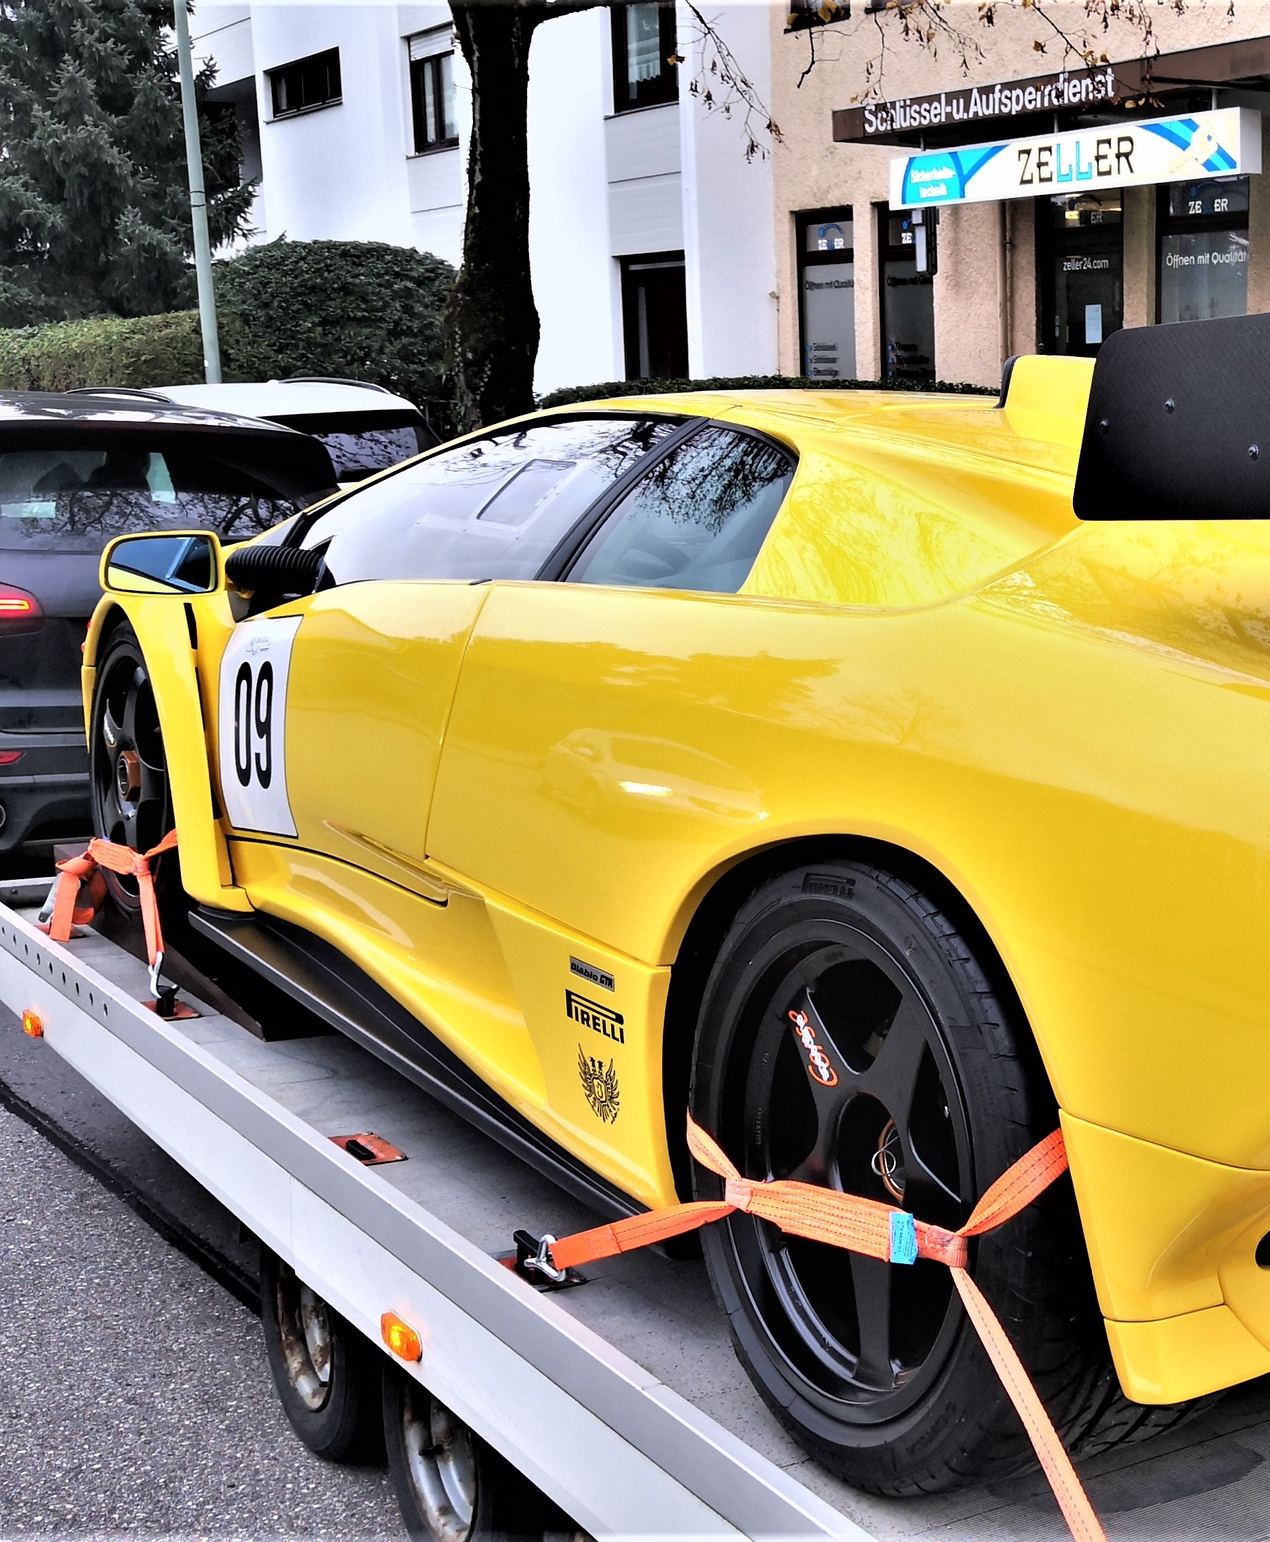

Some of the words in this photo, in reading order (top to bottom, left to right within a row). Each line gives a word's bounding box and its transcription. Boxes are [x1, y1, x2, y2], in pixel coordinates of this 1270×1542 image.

[1017, 136, 1135, 185] ZELLER
[1063, 257, 1109, 271] zeller24.com
[1166, 252, 1195, 268] Öffnen
[1197, 252, 1210, 266] mit
[1211, 250, 1247, 266] Qualität
[234, 660, 274, 790] 09
[570, 962, 599, 982] Diablo
[565, 988, 625, 1045] PIRELLI
